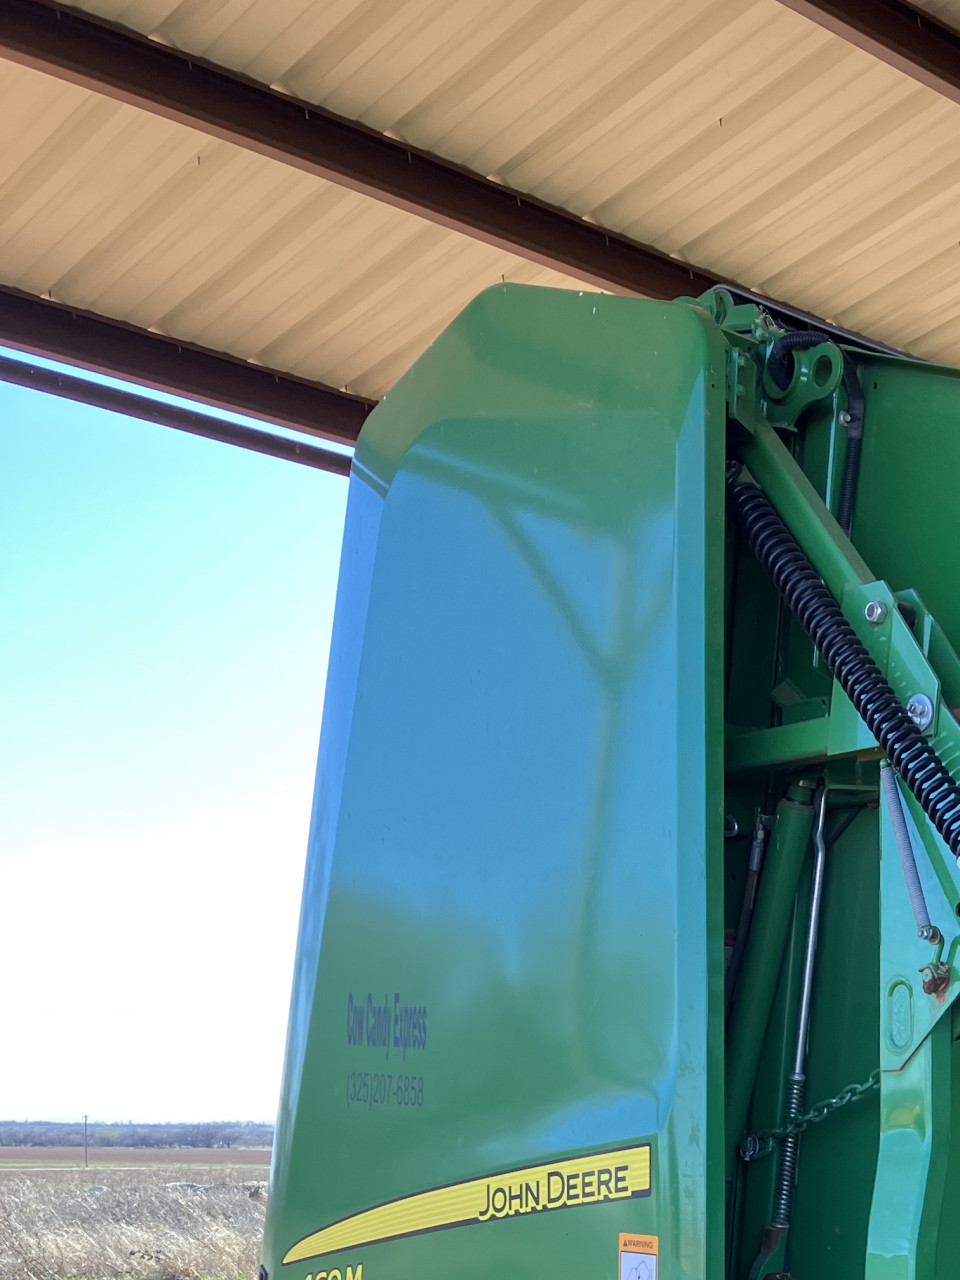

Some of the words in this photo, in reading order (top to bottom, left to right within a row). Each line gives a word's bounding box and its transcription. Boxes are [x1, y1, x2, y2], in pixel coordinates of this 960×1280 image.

[393, 992, 427, 1062] Express
[478, 1180, 541, 1217] JOHN
[546, 1164, 629, 1206] DEERE
[627, 1239, 654, 1249] WARNING
